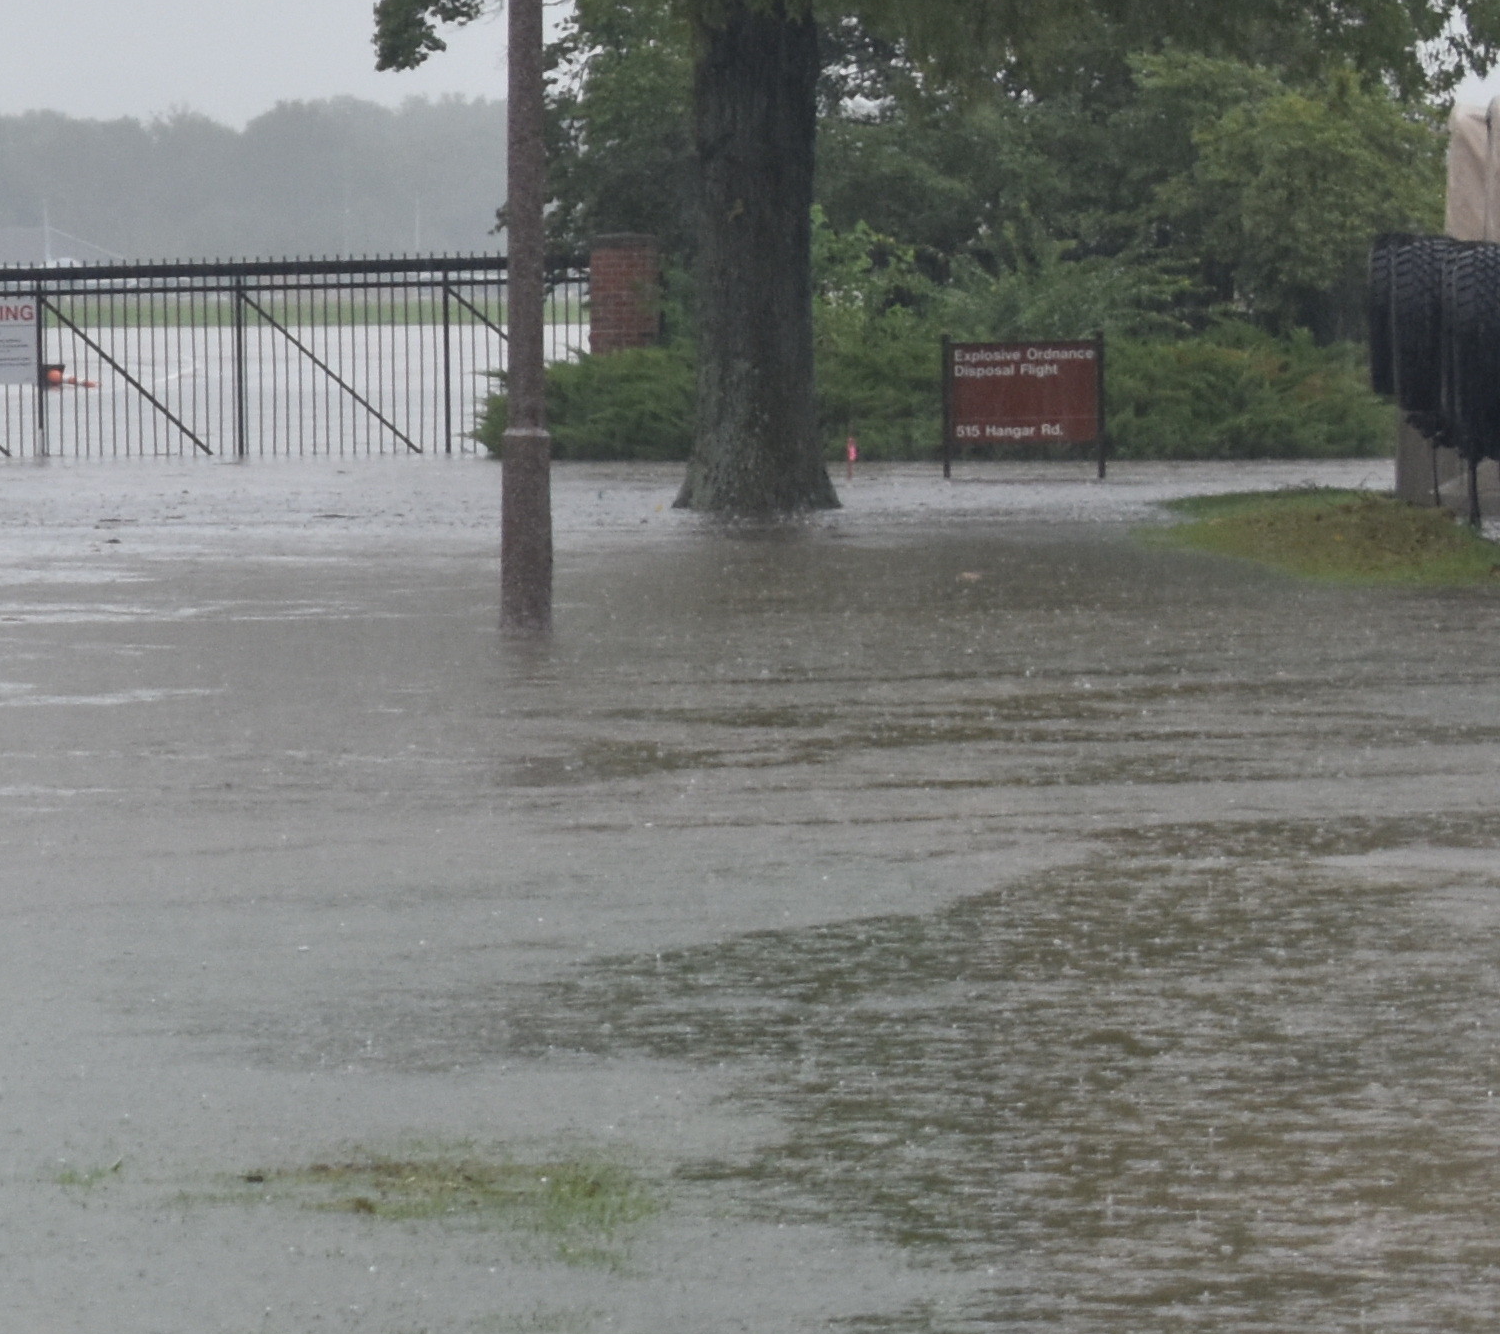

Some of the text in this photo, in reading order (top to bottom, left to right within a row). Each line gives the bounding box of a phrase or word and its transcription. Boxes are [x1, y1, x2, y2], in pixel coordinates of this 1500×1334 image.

[954, 348, 1094, 363] Explosive Ordnance
[954, 363, 1058, 378] Disposal Flight
[956, 424, 1063, 438] 515 Hangar Rd.
